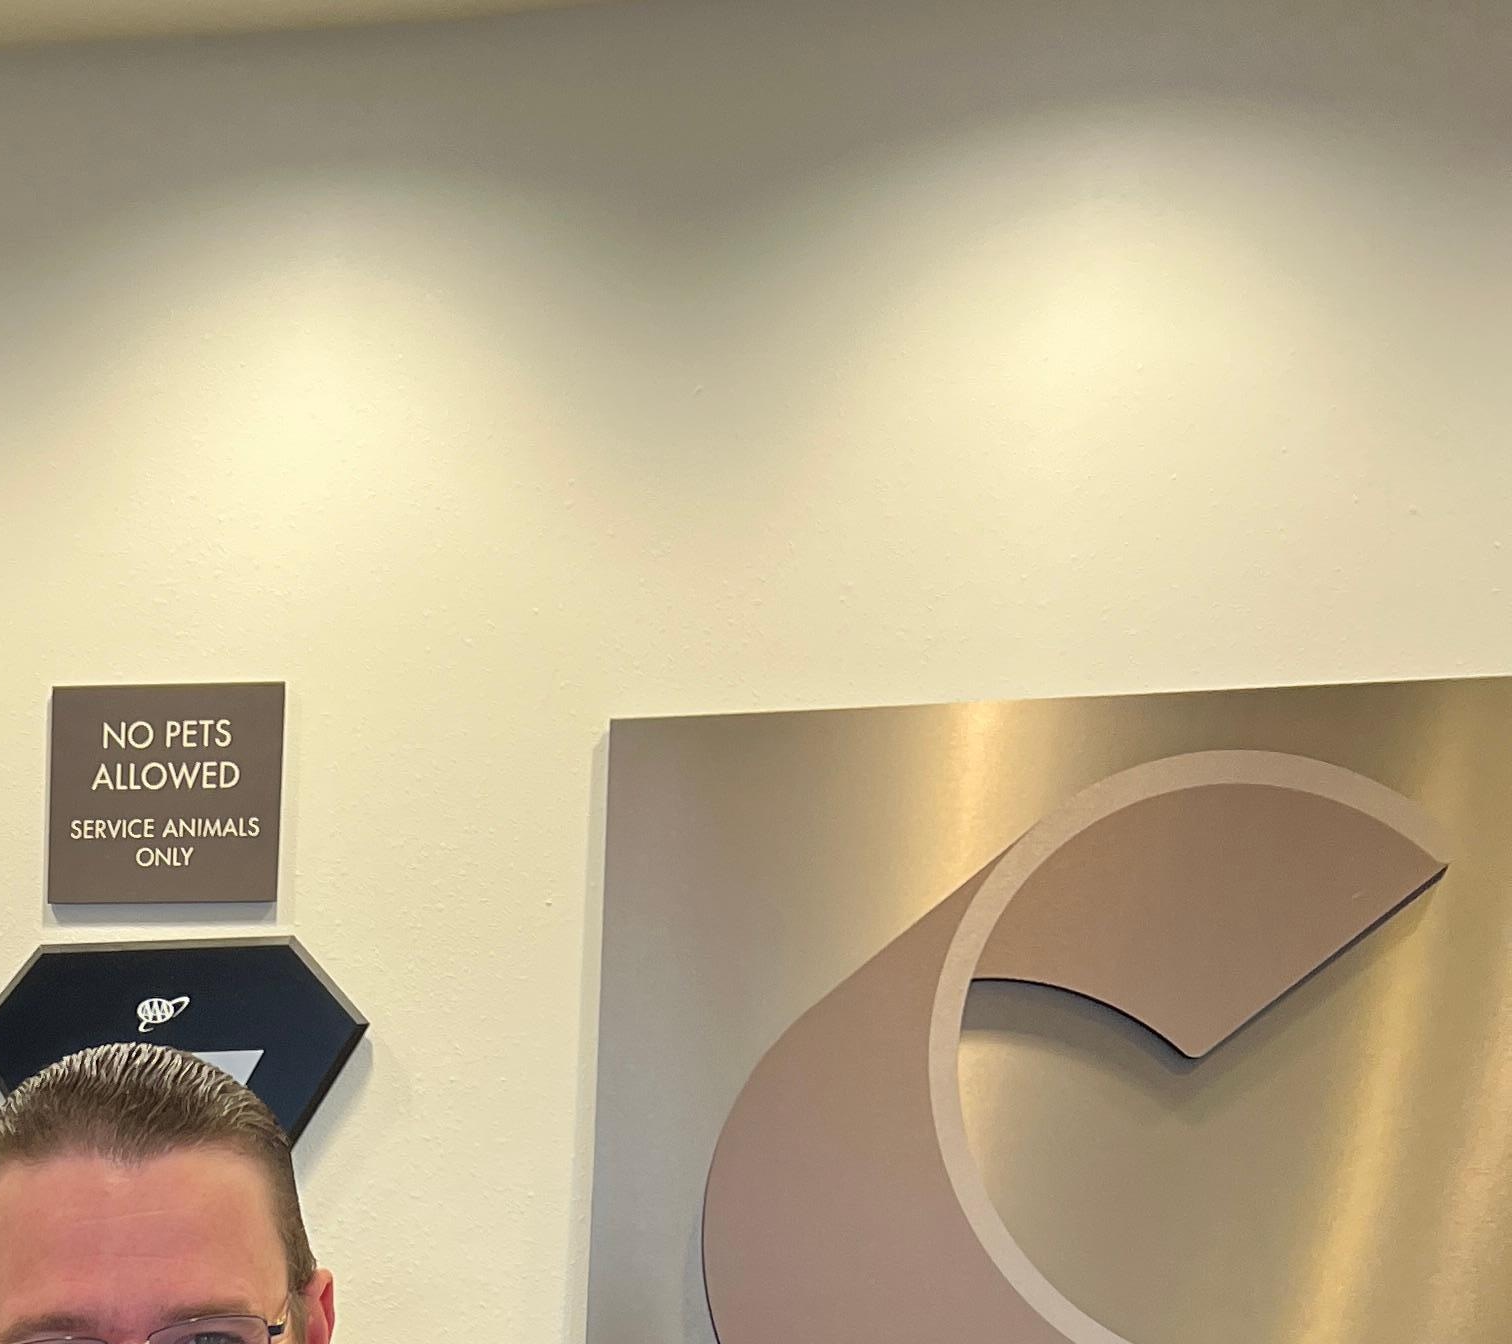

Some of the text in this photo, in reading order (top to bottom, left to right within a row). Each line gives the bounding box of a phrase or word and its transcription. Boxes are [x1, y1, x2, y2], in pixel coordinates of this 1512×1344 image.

[102, 719, 232, 750] NO PETS
[91, 761, 240, 791] ALLOWED
[70, 817, 260, 840] SERVICE ANIMALS
[135, 847, 194, 867] ONLY
